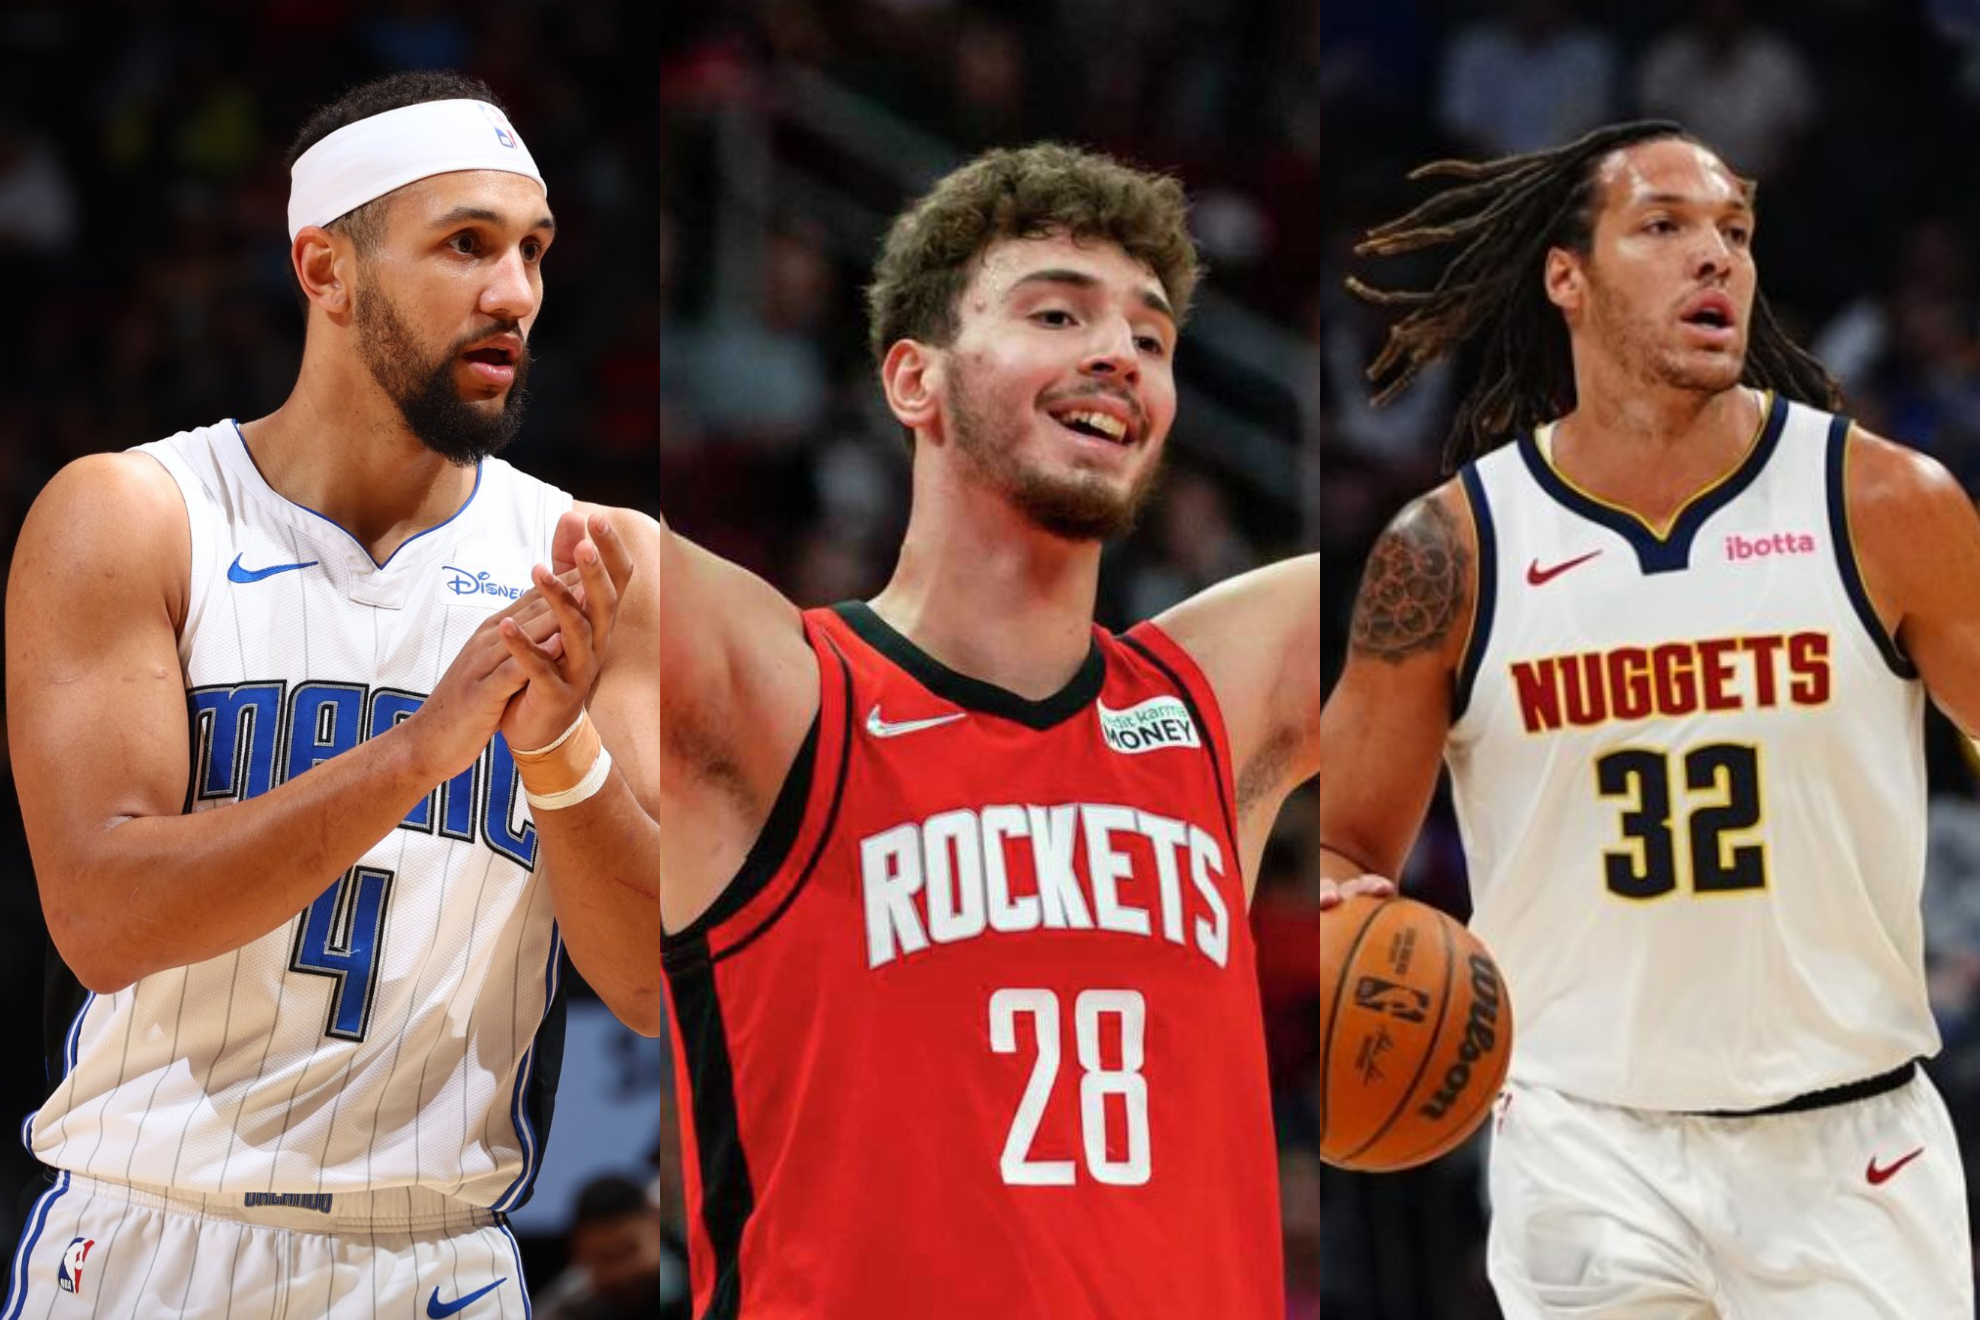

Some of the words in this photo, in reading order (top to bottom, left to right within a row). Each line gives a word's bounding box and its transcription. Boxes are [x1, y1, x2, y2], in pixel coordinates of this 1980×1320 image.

[1725, 532, 1816, 562] ibotta
[1103, 718, 1191, 750] MONEY
[1509, 630, 1832, 735] NUGGETS
[860, 803, 1230, 970] ROCKETS
[1594, 741, 1769, 901] 32
[288, 865, 395, 1043] 4
[988, 987, 1152, 1186] 28
[60, 1277, 72, 1291] NBA
